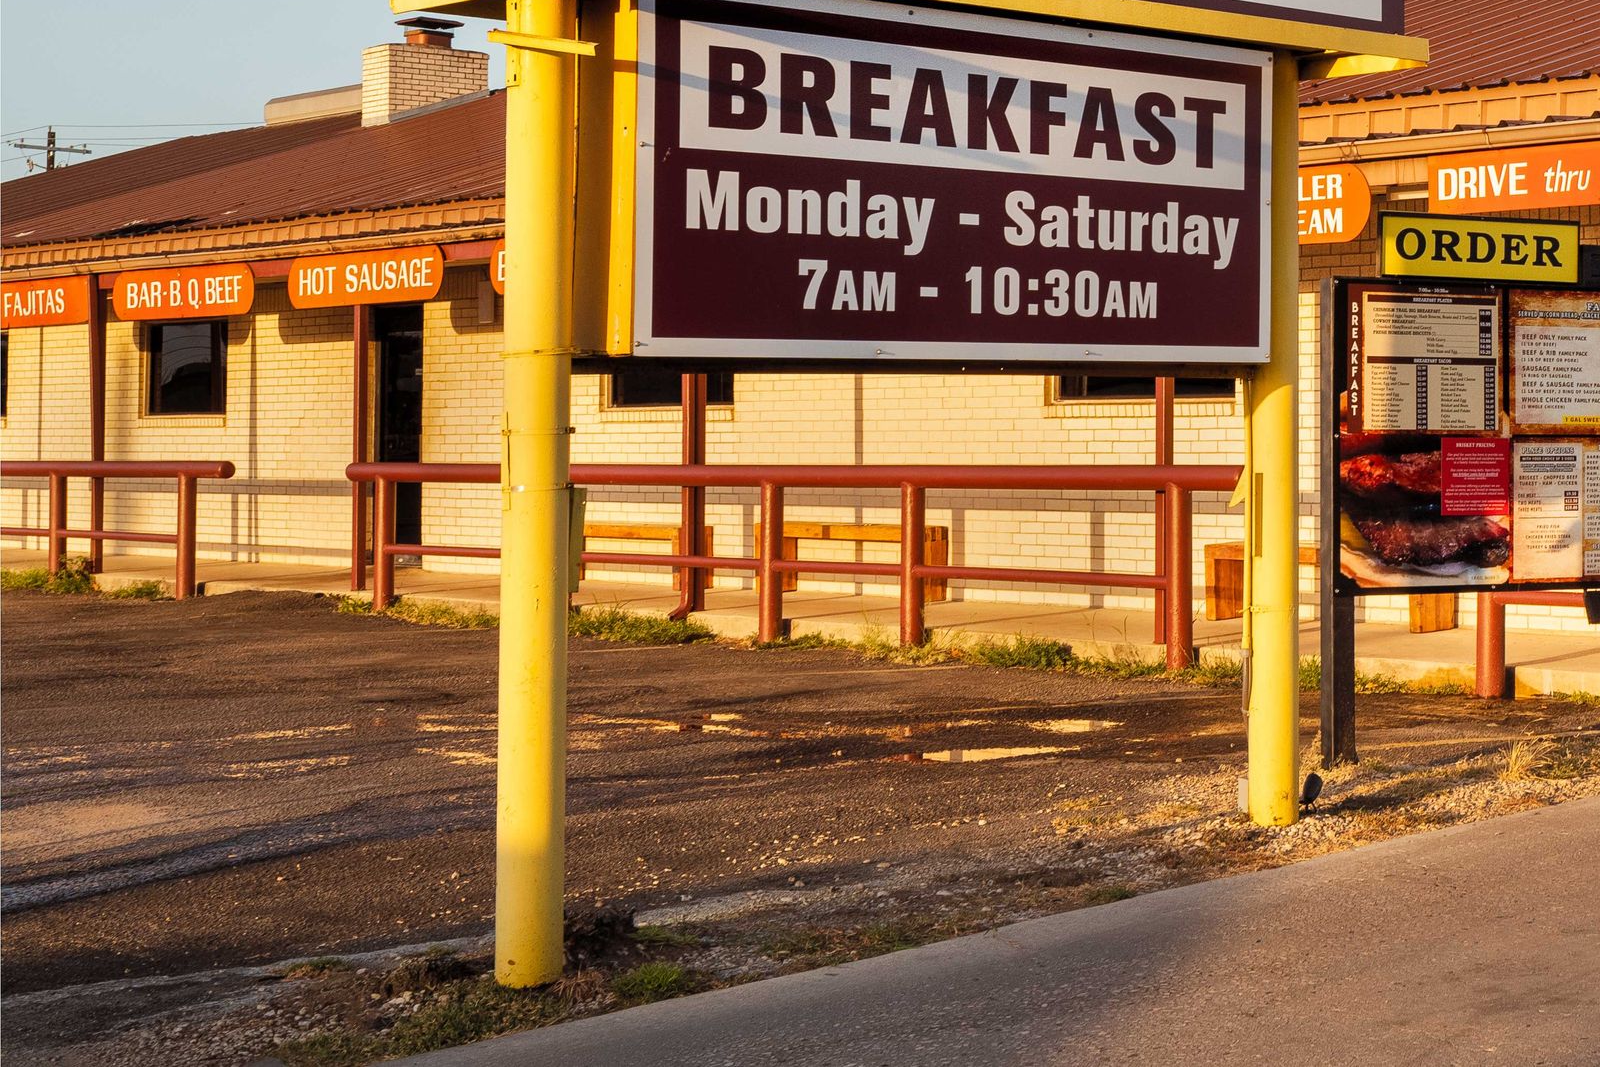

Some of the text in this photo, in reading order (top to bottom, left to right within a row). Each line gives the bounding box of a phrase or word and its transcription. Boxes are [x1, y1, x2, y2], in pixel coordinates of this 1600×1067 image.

[708, 45, 1227, 169] BREAKFAST
[1437, 161, 1528, 201] DRIVE
[1543, 159, 1591, 194] thru
[685, 168, 936, 256] Monday
[1003, 190, 1240, 270] Saturday
[1395, 228, 1563, 268] ORDER
[205, 275, 243, 305] BEEF
[299, 257, 434, 296] HOT SAUSAGE
[798, 258, 896, 312] 7AM
[965, 266, 1158, 319] 10:30AM
[4, 288, 65, 317] FAJITAS
[1351, 302, 1359, 416] BREAKFAST
